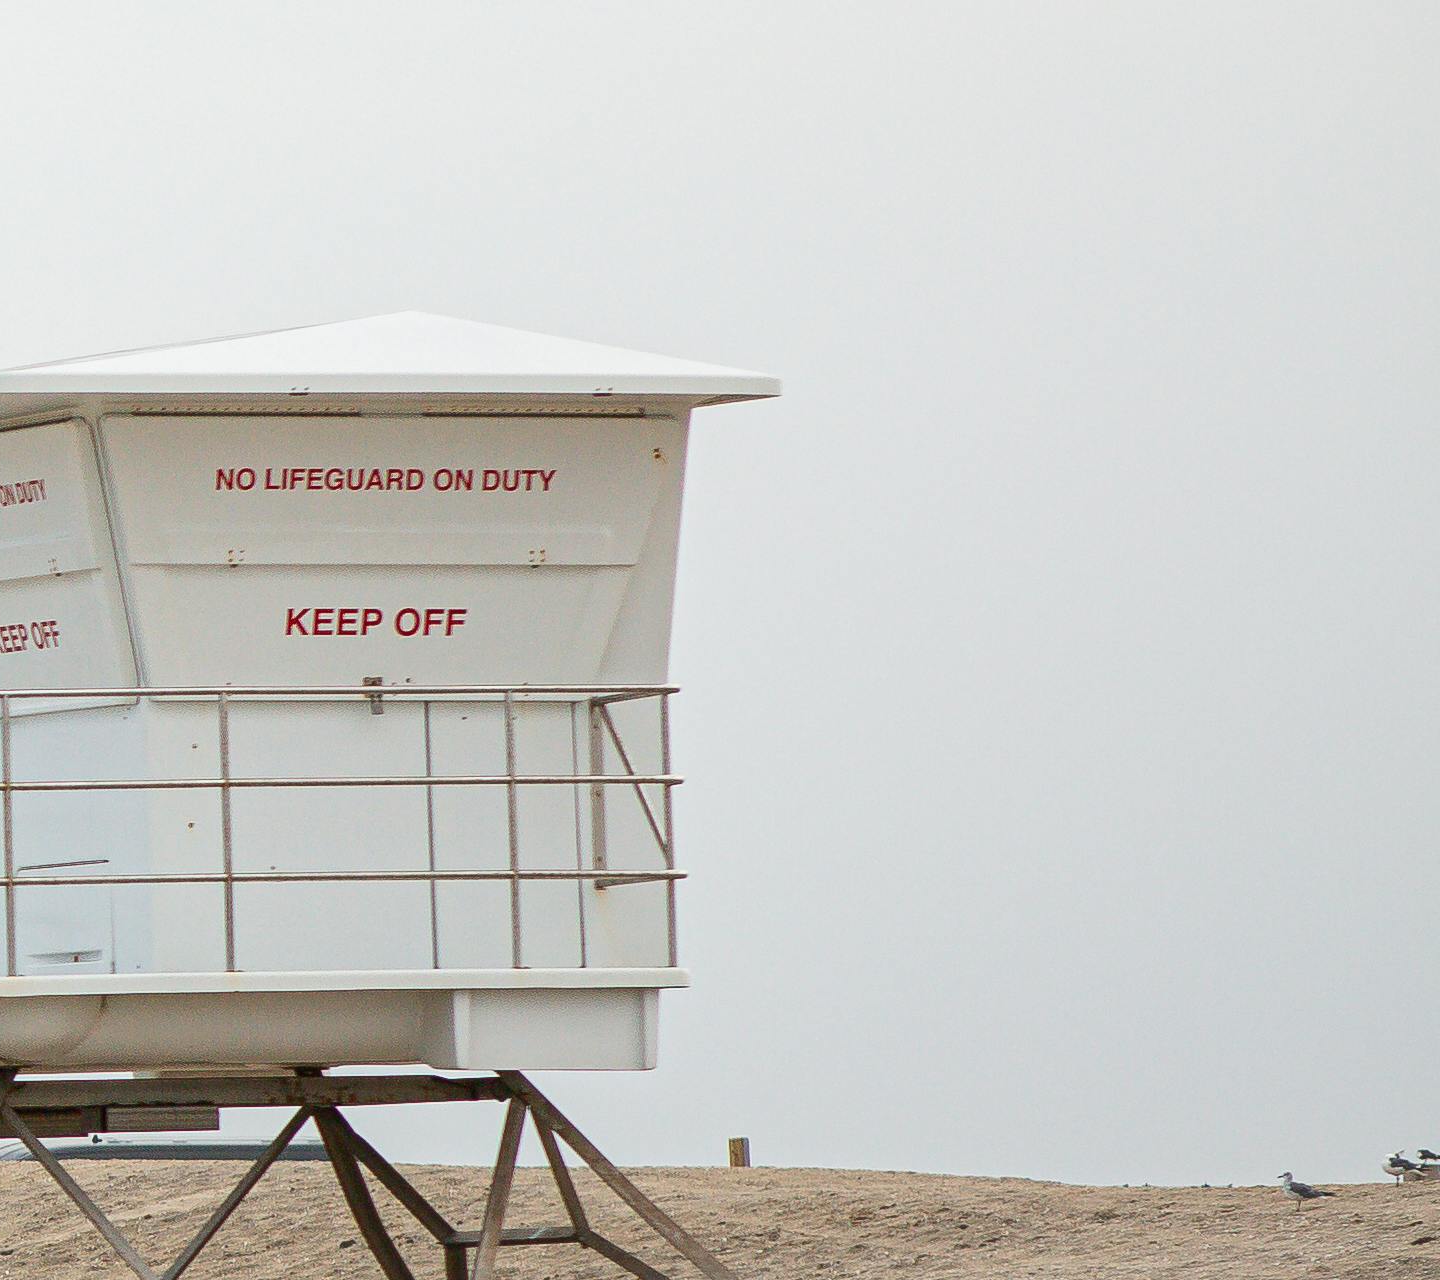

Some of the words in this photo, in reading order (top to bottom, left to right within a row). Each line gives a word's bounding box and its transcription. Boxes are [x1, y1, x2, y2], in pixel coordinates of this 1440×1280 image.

[15, 479, 47, 504] DUTY
[214, 467, 257, 493] NO
[263, 467, 427, 493] LIFEGUARD
[432, 468, 475, 493] ON
[482, 468, 558, 493] DUTY
[30, 621, 60, 651] OFF
[284, 608, 384, 637] KEEP
[393, 607, 467, 637] OFF
